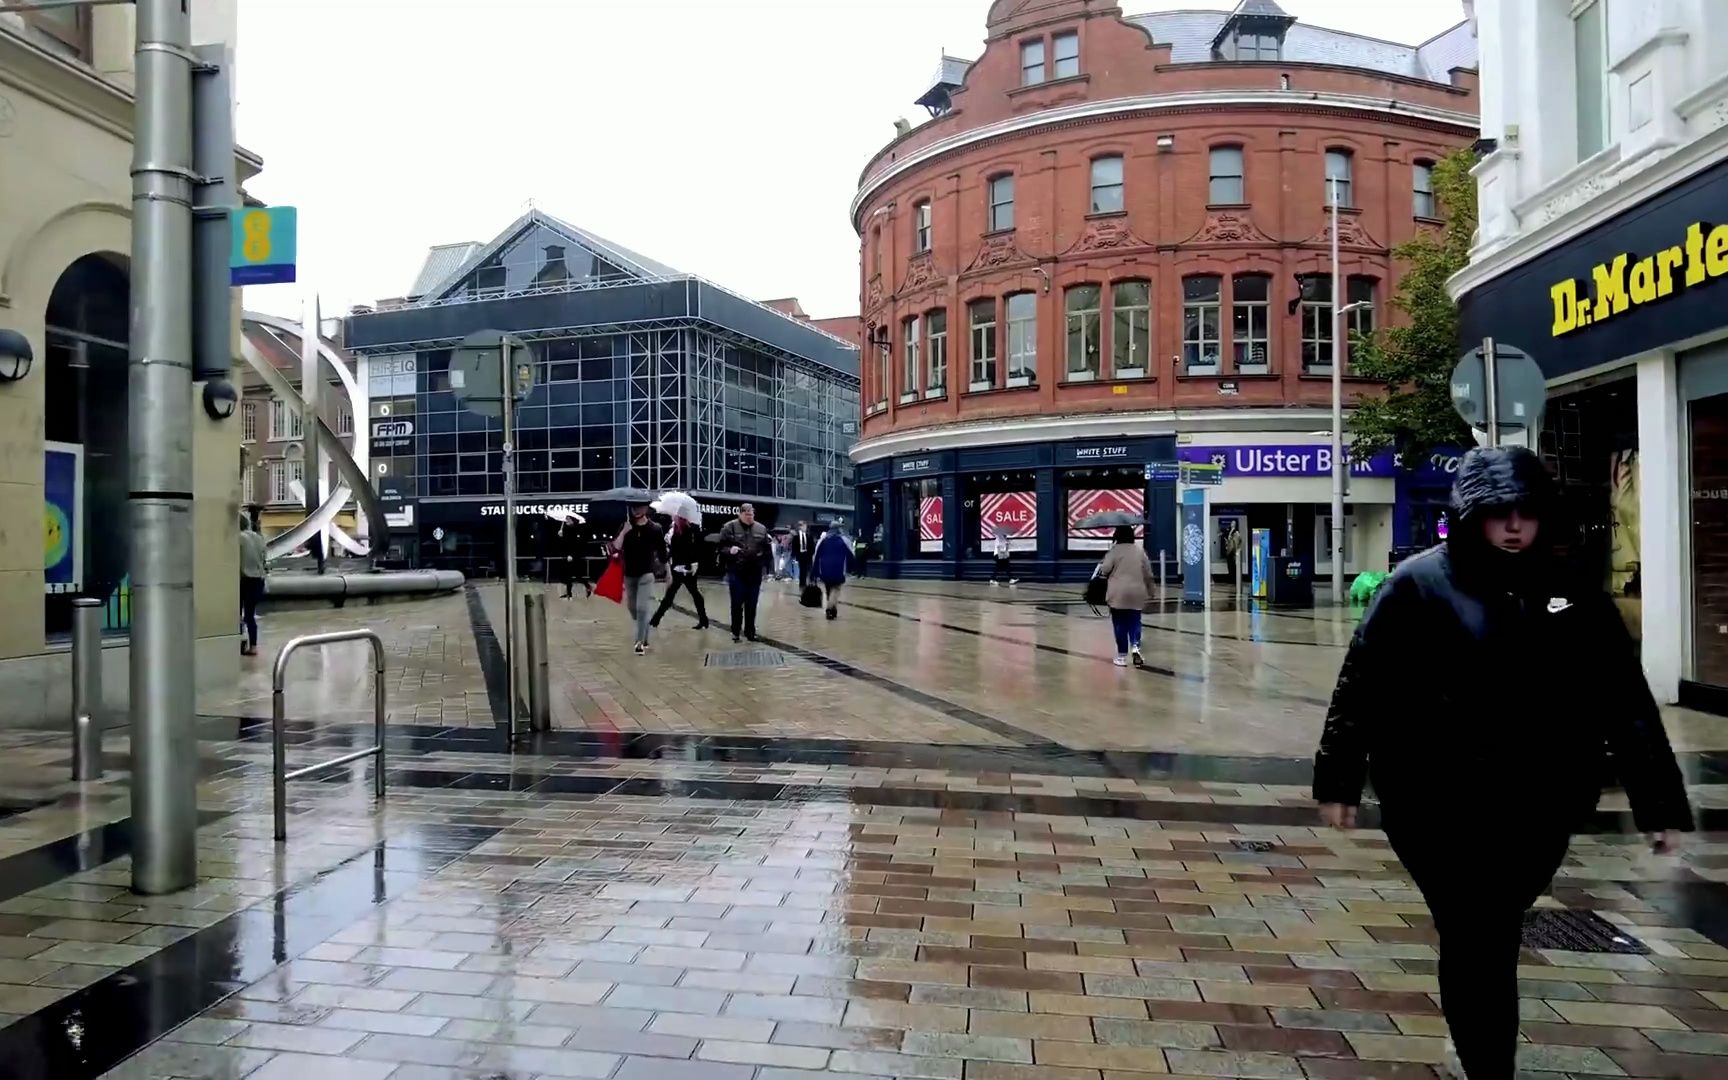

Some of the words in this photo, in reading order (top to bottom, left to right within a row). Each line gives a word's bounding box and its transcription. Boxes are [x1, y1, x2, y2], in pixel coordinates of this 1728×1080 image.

[1103, 446, 1127, 454] STUFF
[1236, 449, 1311, 472] Ulster
[926, 512, 943, 524] SAL
[995, 510, 1027, 522] SALE
